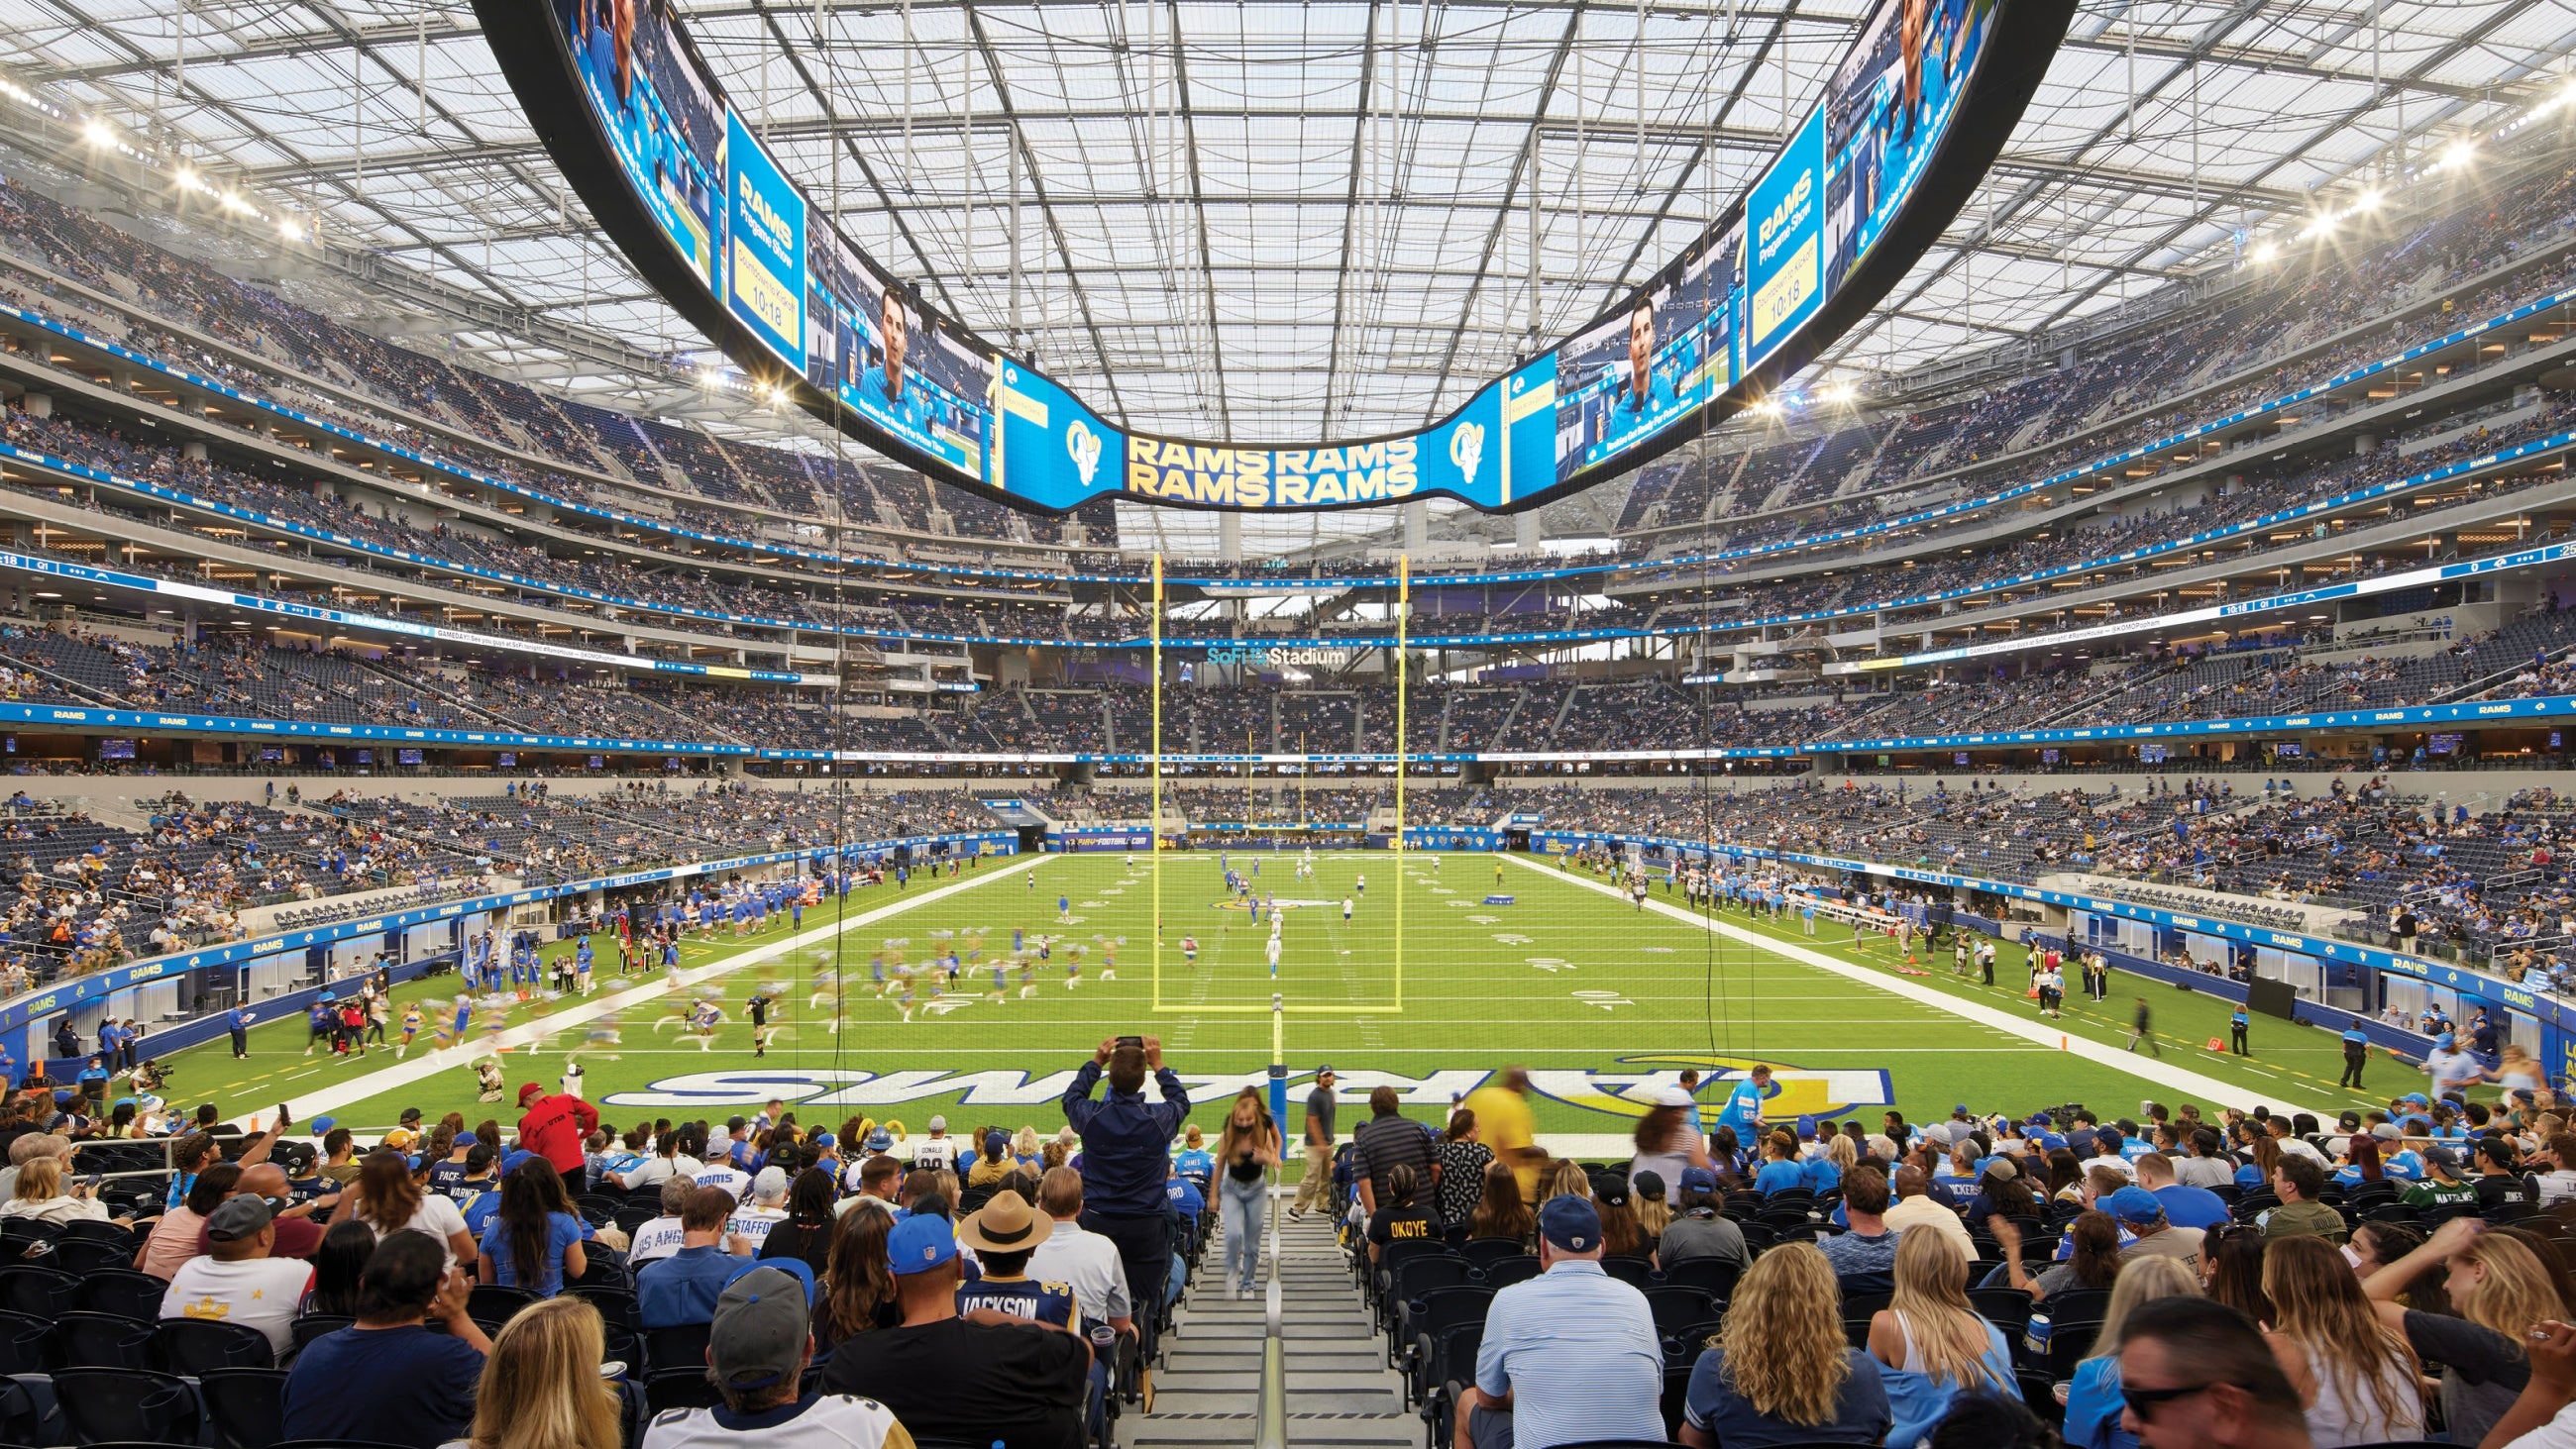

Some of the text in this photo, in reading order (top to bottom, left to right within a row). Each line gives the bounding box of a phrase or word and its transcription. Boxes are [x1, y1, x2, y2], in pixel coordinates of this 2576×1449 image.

[739, 170, 793, 251] RAMS
[1759, 167, 1812, 247] RAMS
[740, 200, 793, 269] Pregame Show
[1759, 199, 1811, 266] Pregame Show
[738, 249, 770, 292] Countdown
[776, 288, 796, 314] Kickoff
[1756, 278, 1786, 310] Countdown
[1794, 247, 1815, 273] Kickoff
[1771, 279, 1799, 322] 10:18
[2554, 288, 2576, 301] RAM
[753, 285, 782, 327] 10:18
[2464, 323, 2489, 336] RAMS
[84, 336, 108, 350] RAMS
[1607, 437, 1627, 452] Rookies
[1628, 430, 1637, 442] Get
[1663, 405, 1679, 421] Prime
[1679, 397, 1693, 410] Time
[932, 441, 945, 455] Time
[16, 450, 45, 463] RAMS
[1129, 436, 1417, 475] RAMS RAMS
[2470, 456, 2496, 467] RAMS
[111, 475, 135, 487] RAMS
[1129, 462, 1418, 506] RAMS RAMS
[2385, 479, 2408, 491] RAMS
[192, 498, 214, 509] RAMS
[2308, 501, 2328, 511] RAMS
[267, 517, 286, 527] RAMS
[38, 562, 49, 570] Q1
[2471, 562, 2478, 572] 0
[2226, 603, 2247, 614] 10:18
[349, 615, 421, 634] #RAMSHOUSE
[1207, 648, 1344, 665] SoFi Stadium
[54, 711, 86, 720] RAMS
[2376, 711, 2404, 721] RAMS
[2479, 704, 2511, 714] RAMS
[160, 717, 187, 726] RAMS
[512, 892, 531, 902] RAMS
[2023, 888, 2042, 898] RAMS
[440, 905, 463, 916] RAMS
[2092, 900, 2113, 911] RAMS
[357, 920, 383, 933] RAMS
[2173, 915, 2198, 929] RAMS
[253, 939, 284, 954] RAMS
[2272, 934, 2303, 949] RAMS
[130, 964, 163, 981] RAMS
[2393, 958, 2428, 975] RAMS
[28, 995, 56, 1015] RAMS
[2505, 988, 2534, 1008] RAMS
[1743, 1110, 1755, 1119] 55
[1184, 1159, 1201, 1168] JAMES
[1167, 1187, 1184, 1199] ORD
[2505, 1191, 2523, 1202] JONES
[736, 1220, 774, 1235] STAFFO
[1391, 1220, 1428, 1238] OKOYE
[2312, 1215, 2341, 1231] DONALD
[1041, 1282, 1069, 1296] 3
[959, 1296, 1037, 1320] JACKSON
